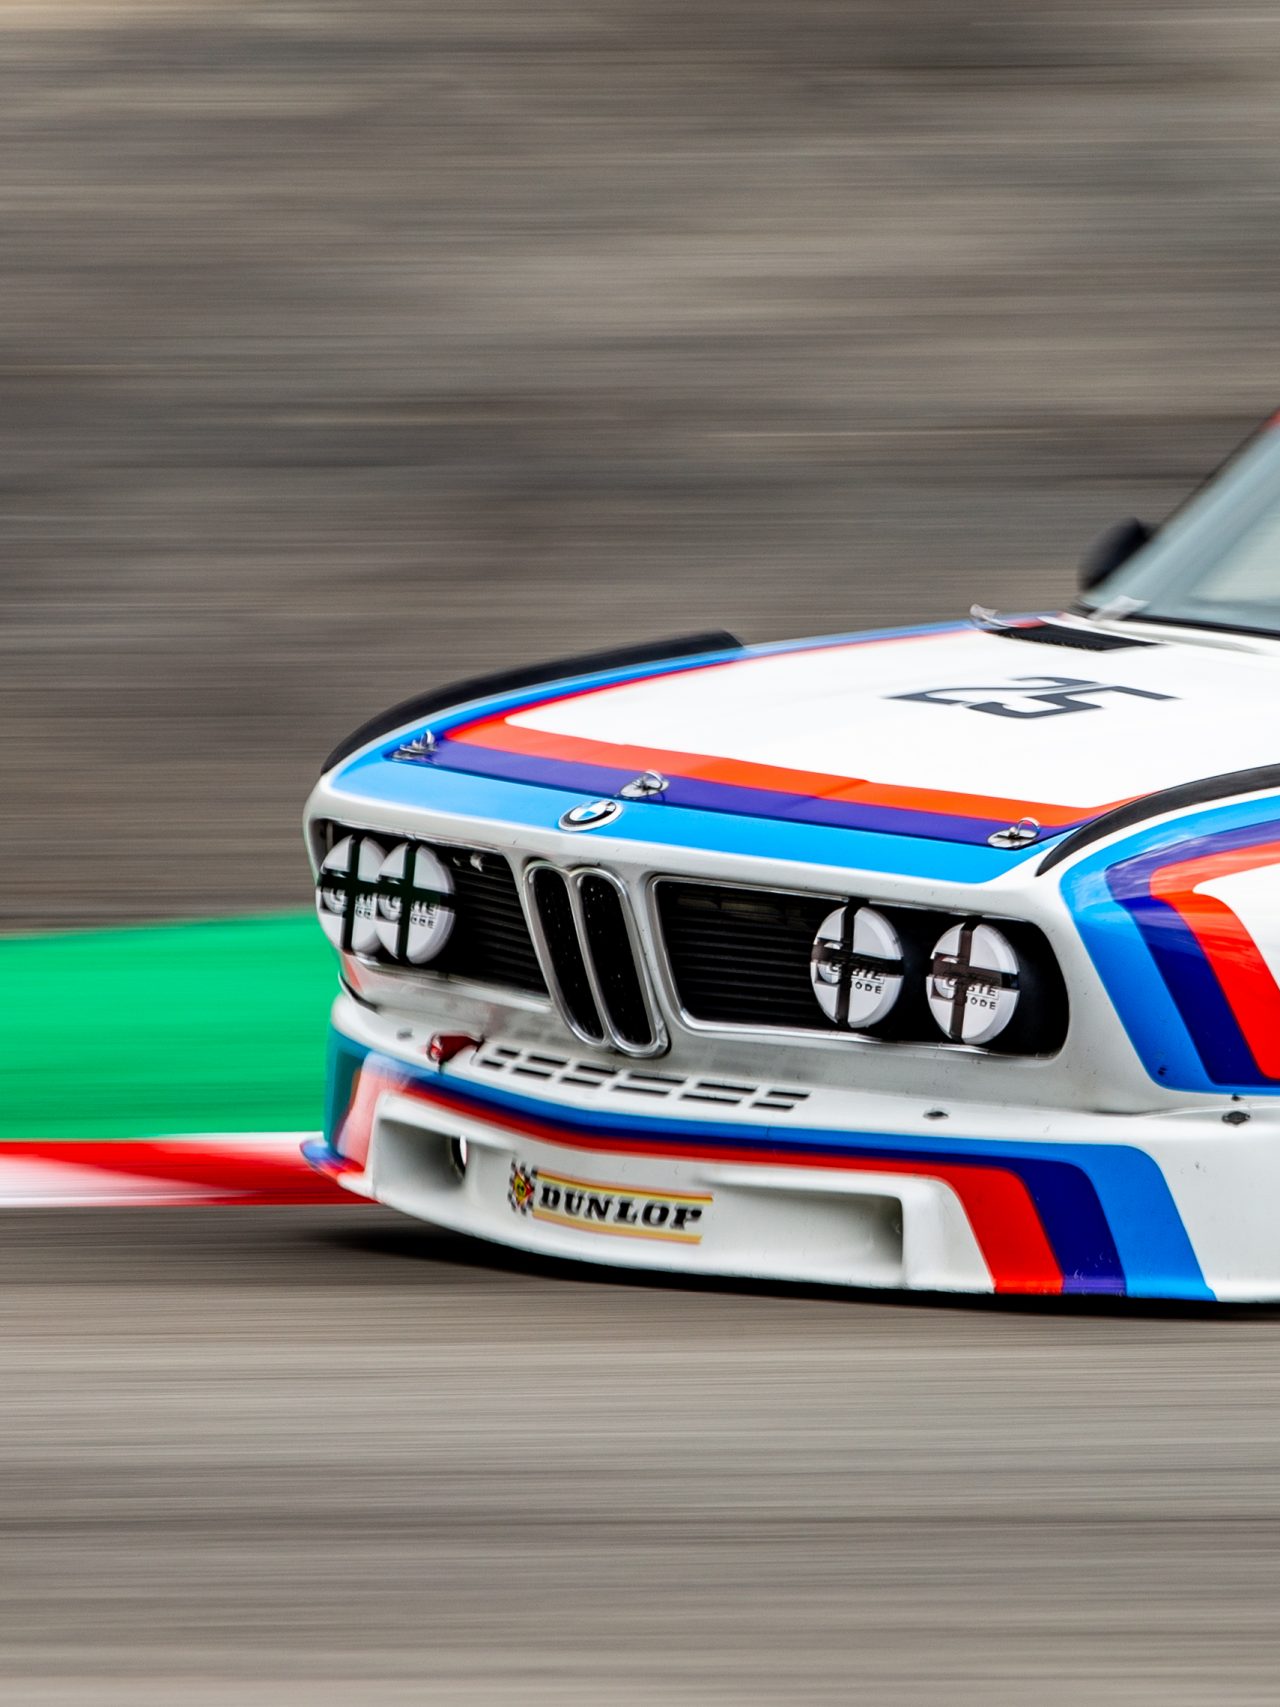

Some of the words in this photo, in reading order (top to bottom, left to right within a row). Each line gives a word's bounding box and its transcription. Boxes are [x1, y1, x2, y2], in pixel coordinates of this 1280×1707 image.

[882, 676, 1180, 718] 25
[851, 979, 882, 995] ODE
[966, 995, 997, 1010] ODE
[540, 1182, 702, 1230] DUNLOP
